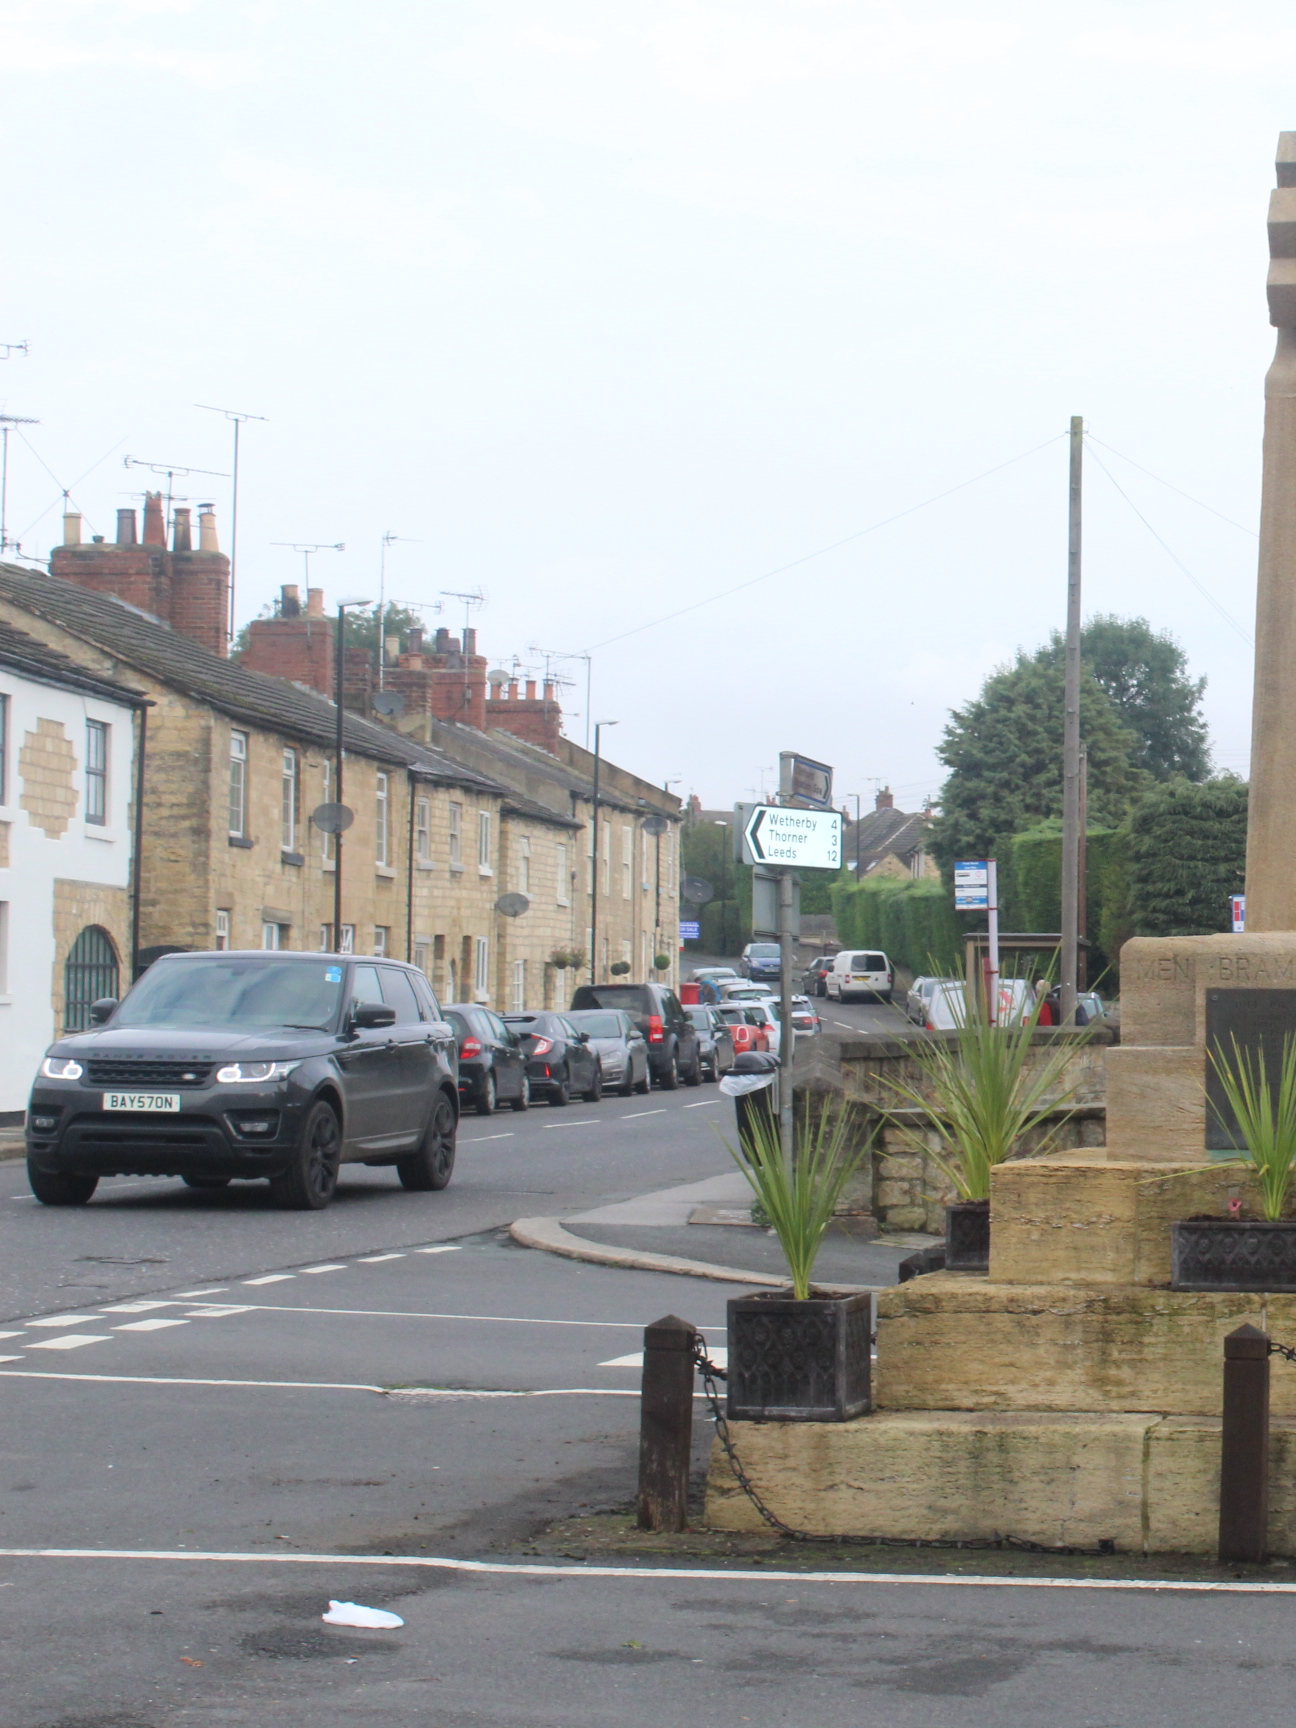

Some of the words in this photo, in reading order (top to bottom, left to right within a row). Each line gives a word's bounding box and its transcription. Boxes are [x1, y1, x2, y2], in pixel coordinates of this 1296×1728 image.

[769, 814, 817, 831] Wetherby
[831, 819, 838, 830] 4
[769, 829, 808, 843] Thorner
[831, 835, 838, 846] 3
[768, 845, 797, 858] Leeds
[827, 850, 838, 861] 12
[1137, 957, 1190, 981] MEN
